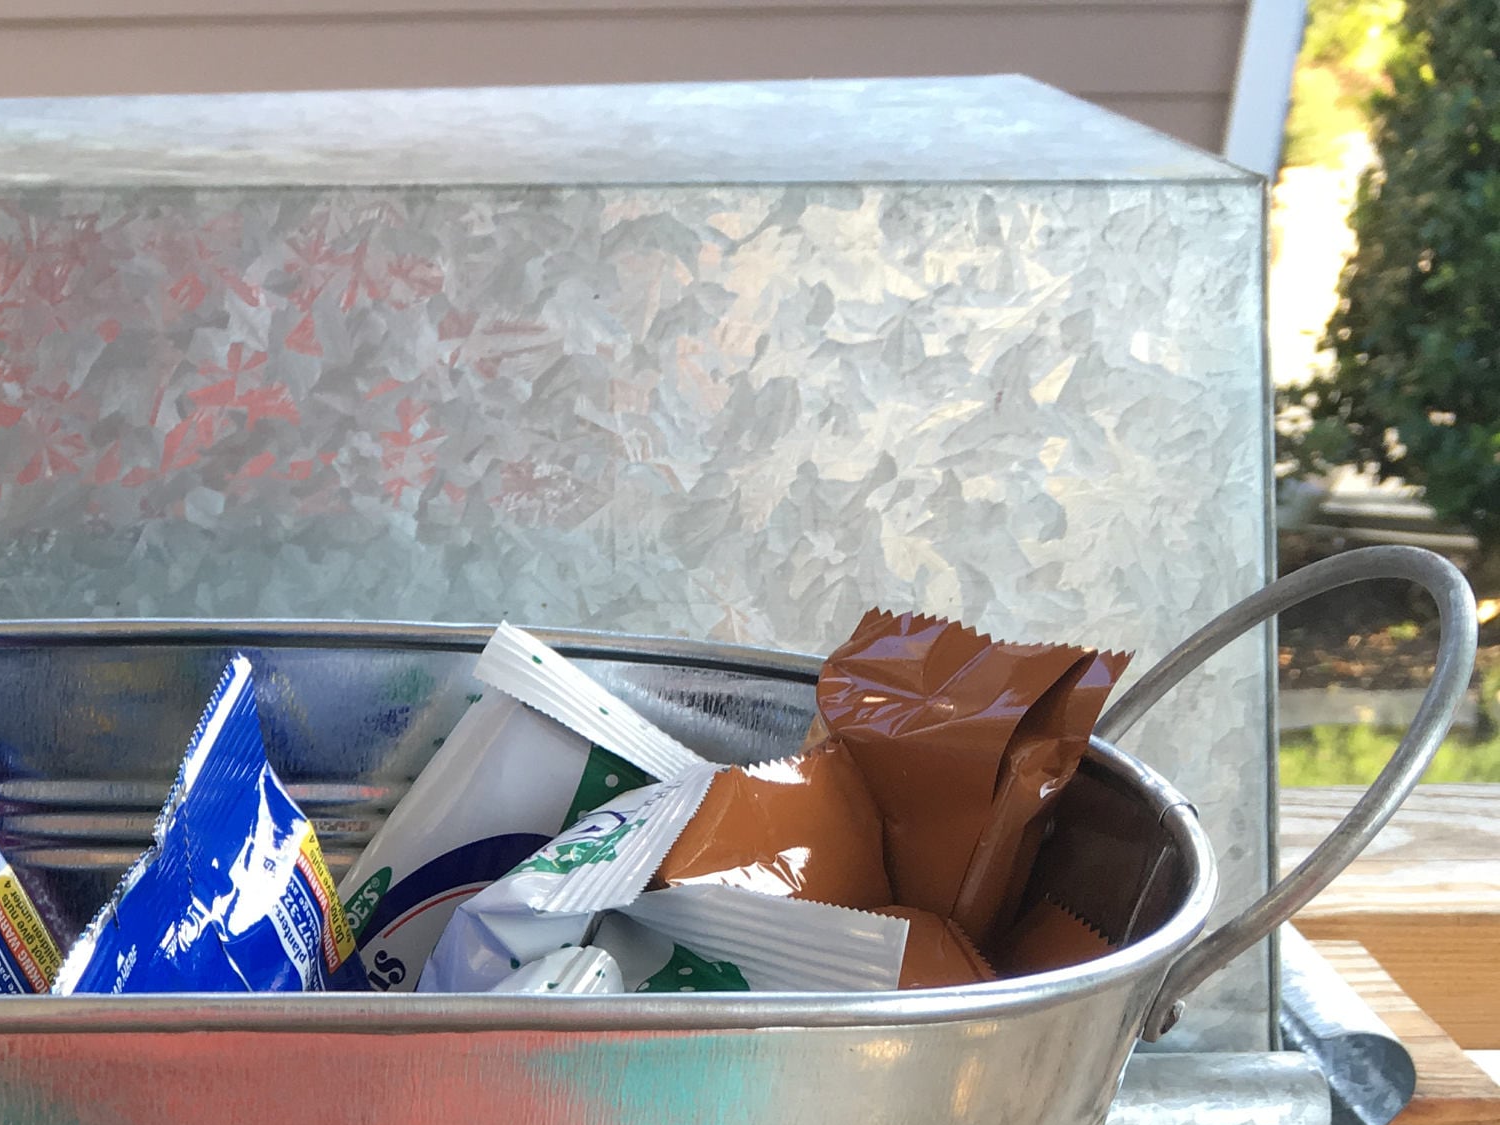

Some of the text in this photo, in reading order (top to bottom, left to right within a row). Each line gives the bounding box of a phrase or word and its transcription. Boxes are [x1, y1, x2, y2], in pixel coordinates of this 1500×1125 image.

[296, 853, 329, 912] WARNIN
[2, 893, 19, 921] nuts
[10, 890, 33, 923] under
[347, 883, 380, 929] OE'S
[17, 920, 36, 945] give
[31, 923, 60, 969] children
[274, 904, 308, 964] planters.
[334, 924, 345, 945] Do
[30, 944, 47, 966] not
